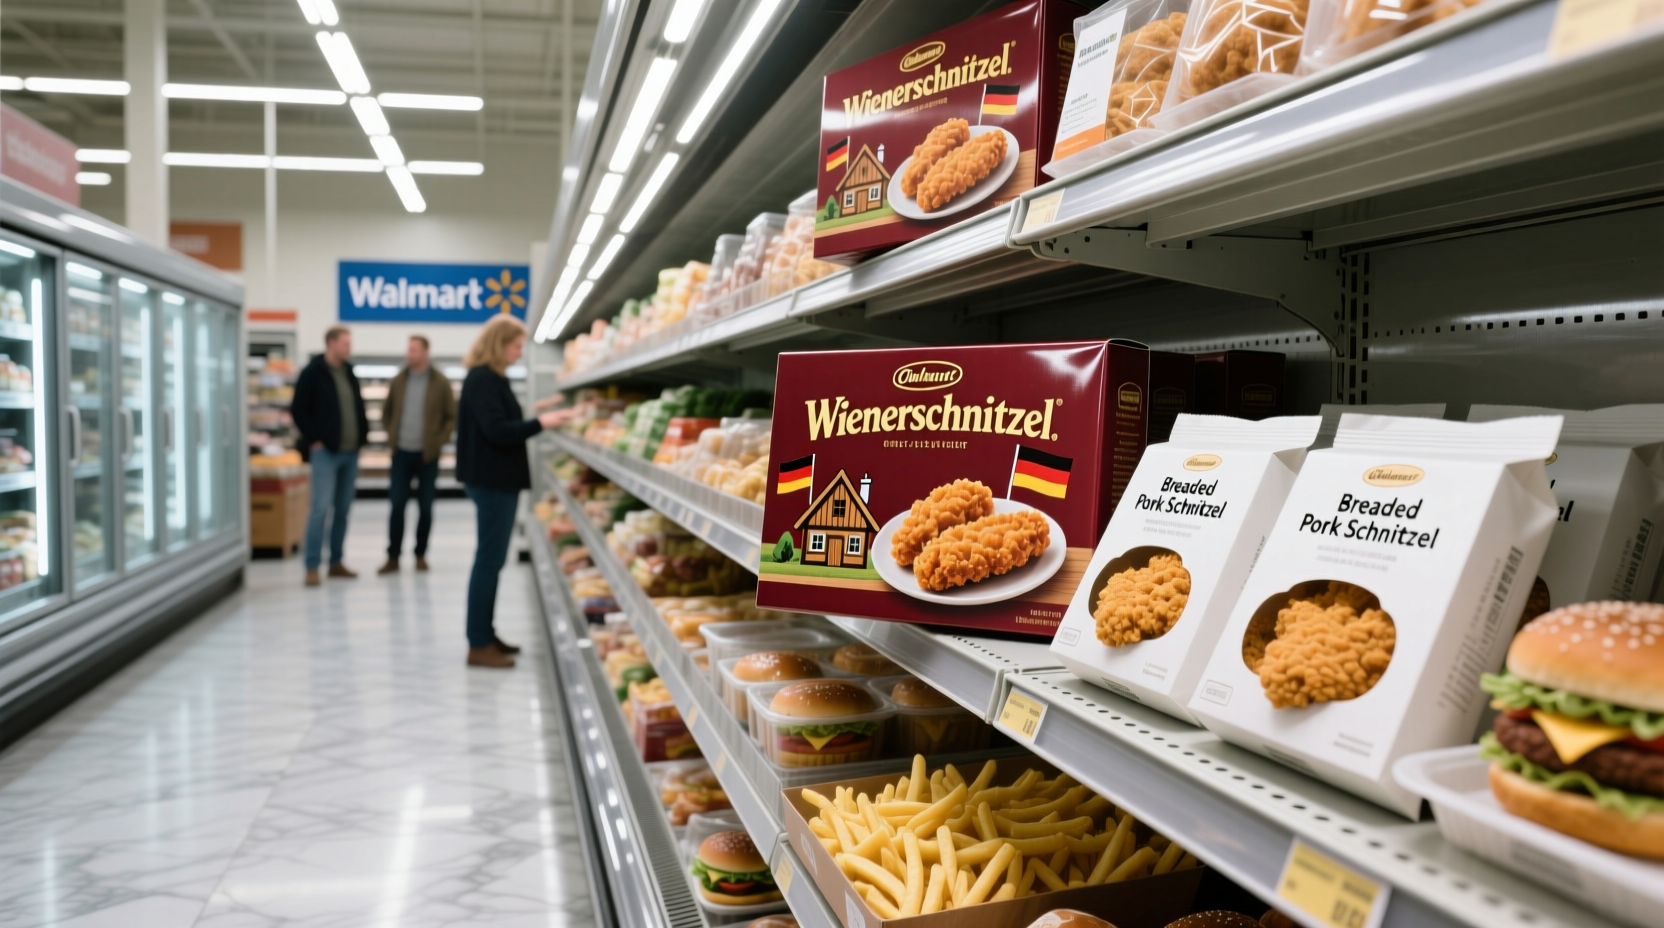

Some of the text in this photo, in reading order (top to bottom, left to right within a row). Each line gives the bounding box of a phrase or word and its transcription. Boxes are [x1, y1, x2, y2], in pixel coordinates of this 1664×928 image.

[347, 275, 484, 310] Walmart
[1161, 477, 1219, 497] Breaded
[1135, 494, 1227, 519] Pork Schnitzel
[1337, 493, 1423, 520] Breaded
[1299, 514, 1440, 549] Pork Schnitzel
